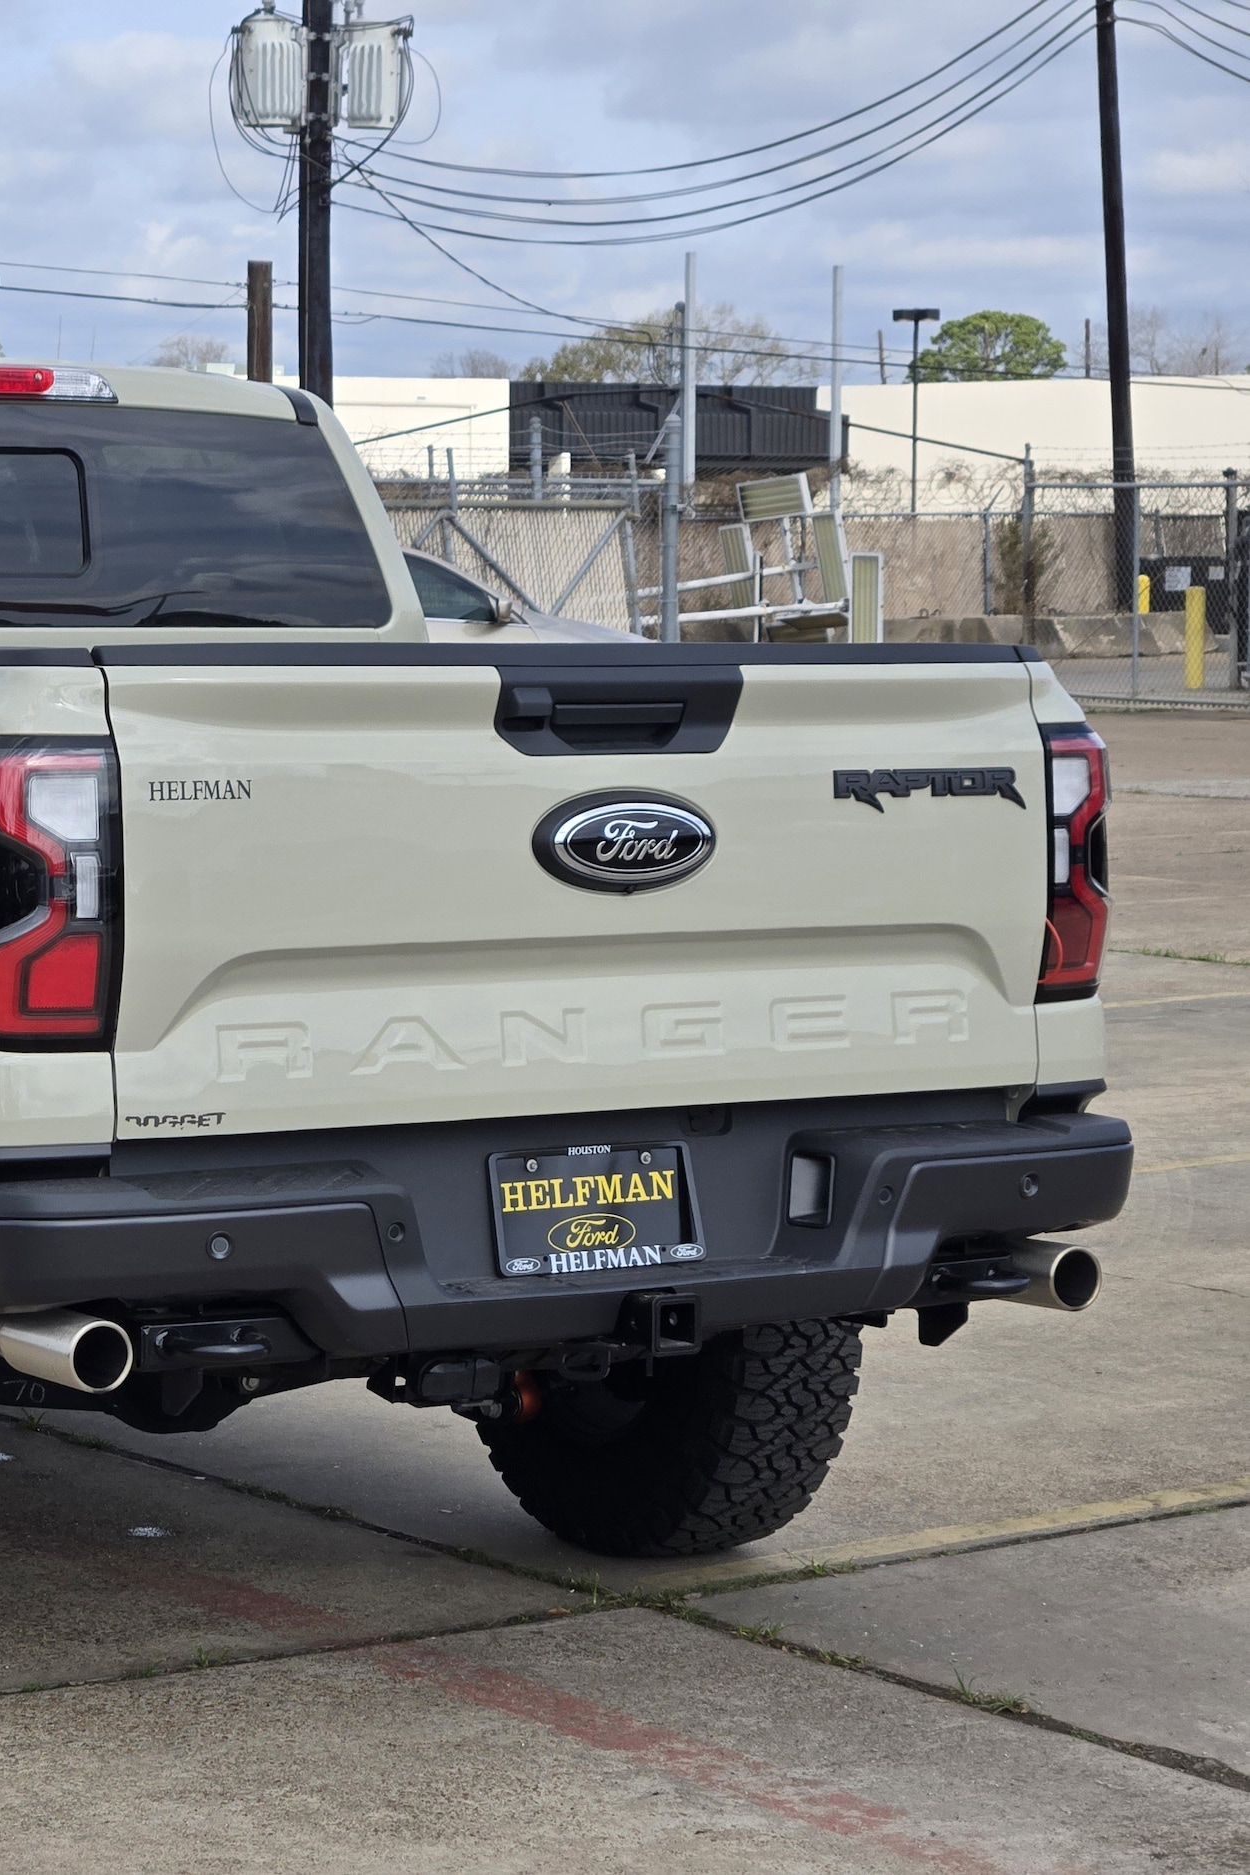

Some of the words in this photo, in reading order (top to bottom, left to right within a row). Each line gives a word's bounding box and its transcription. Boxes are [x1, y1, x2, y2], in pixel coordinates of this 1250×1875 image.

[148, 779, 252, 801] HELFMAN
[833, 766, 1026, 813] RAPTOR
[596, 819, 679, 862] Ford
[215, 988, 970, 1083] RANGER
[567, 1144, 612, 1157] HOUSTON
[501, 1170, 675, 1213] HELFMAN
[566, 1218, 620, 1248] Ford
[512, 1260, 535, 1271] Ford
[549, 1244, 663, 1274] HELFMAN
[676, 1246, 698, 1257] Ford
